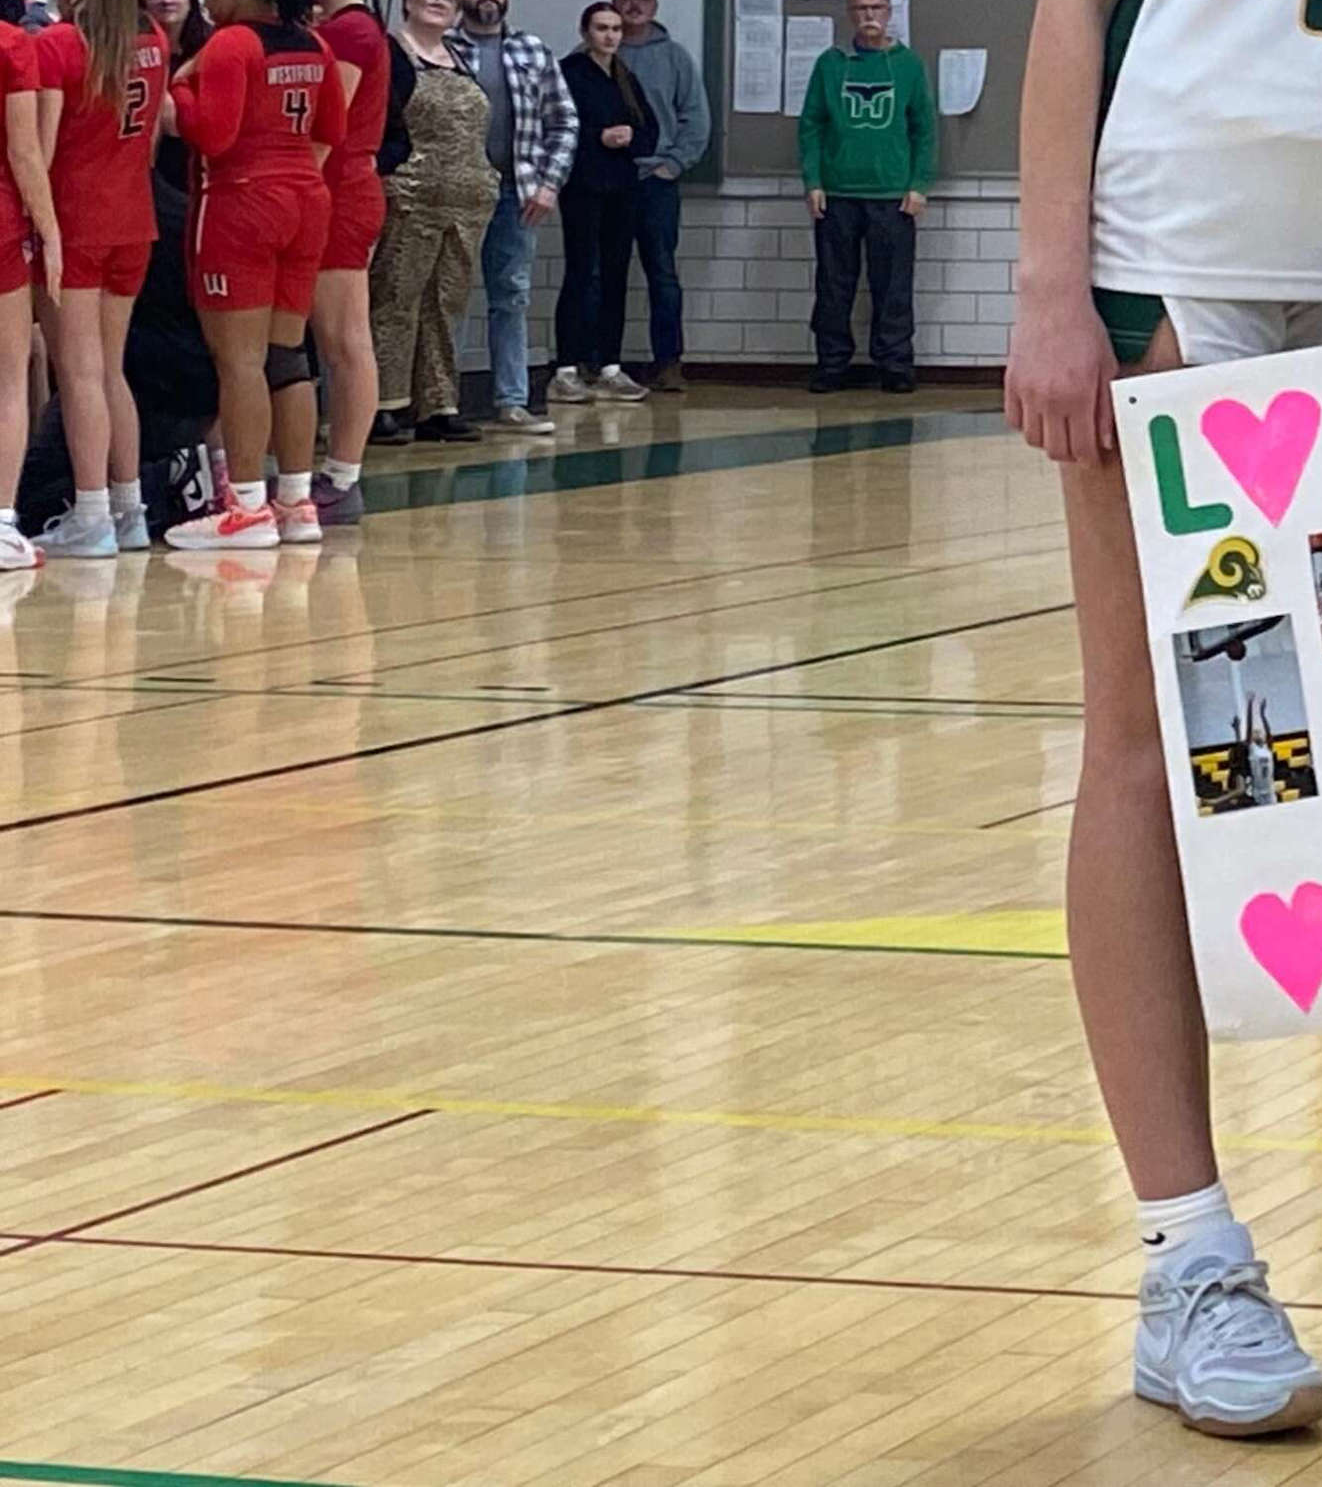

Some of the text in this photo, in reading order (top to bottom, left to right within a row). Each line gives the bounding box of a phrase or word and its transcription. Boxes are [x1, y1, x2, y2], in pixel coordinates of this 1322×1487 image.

[118, 78, 148, 140] 2
[280, 88, 311, 135] 4
[203, 272, 228, 297] W
